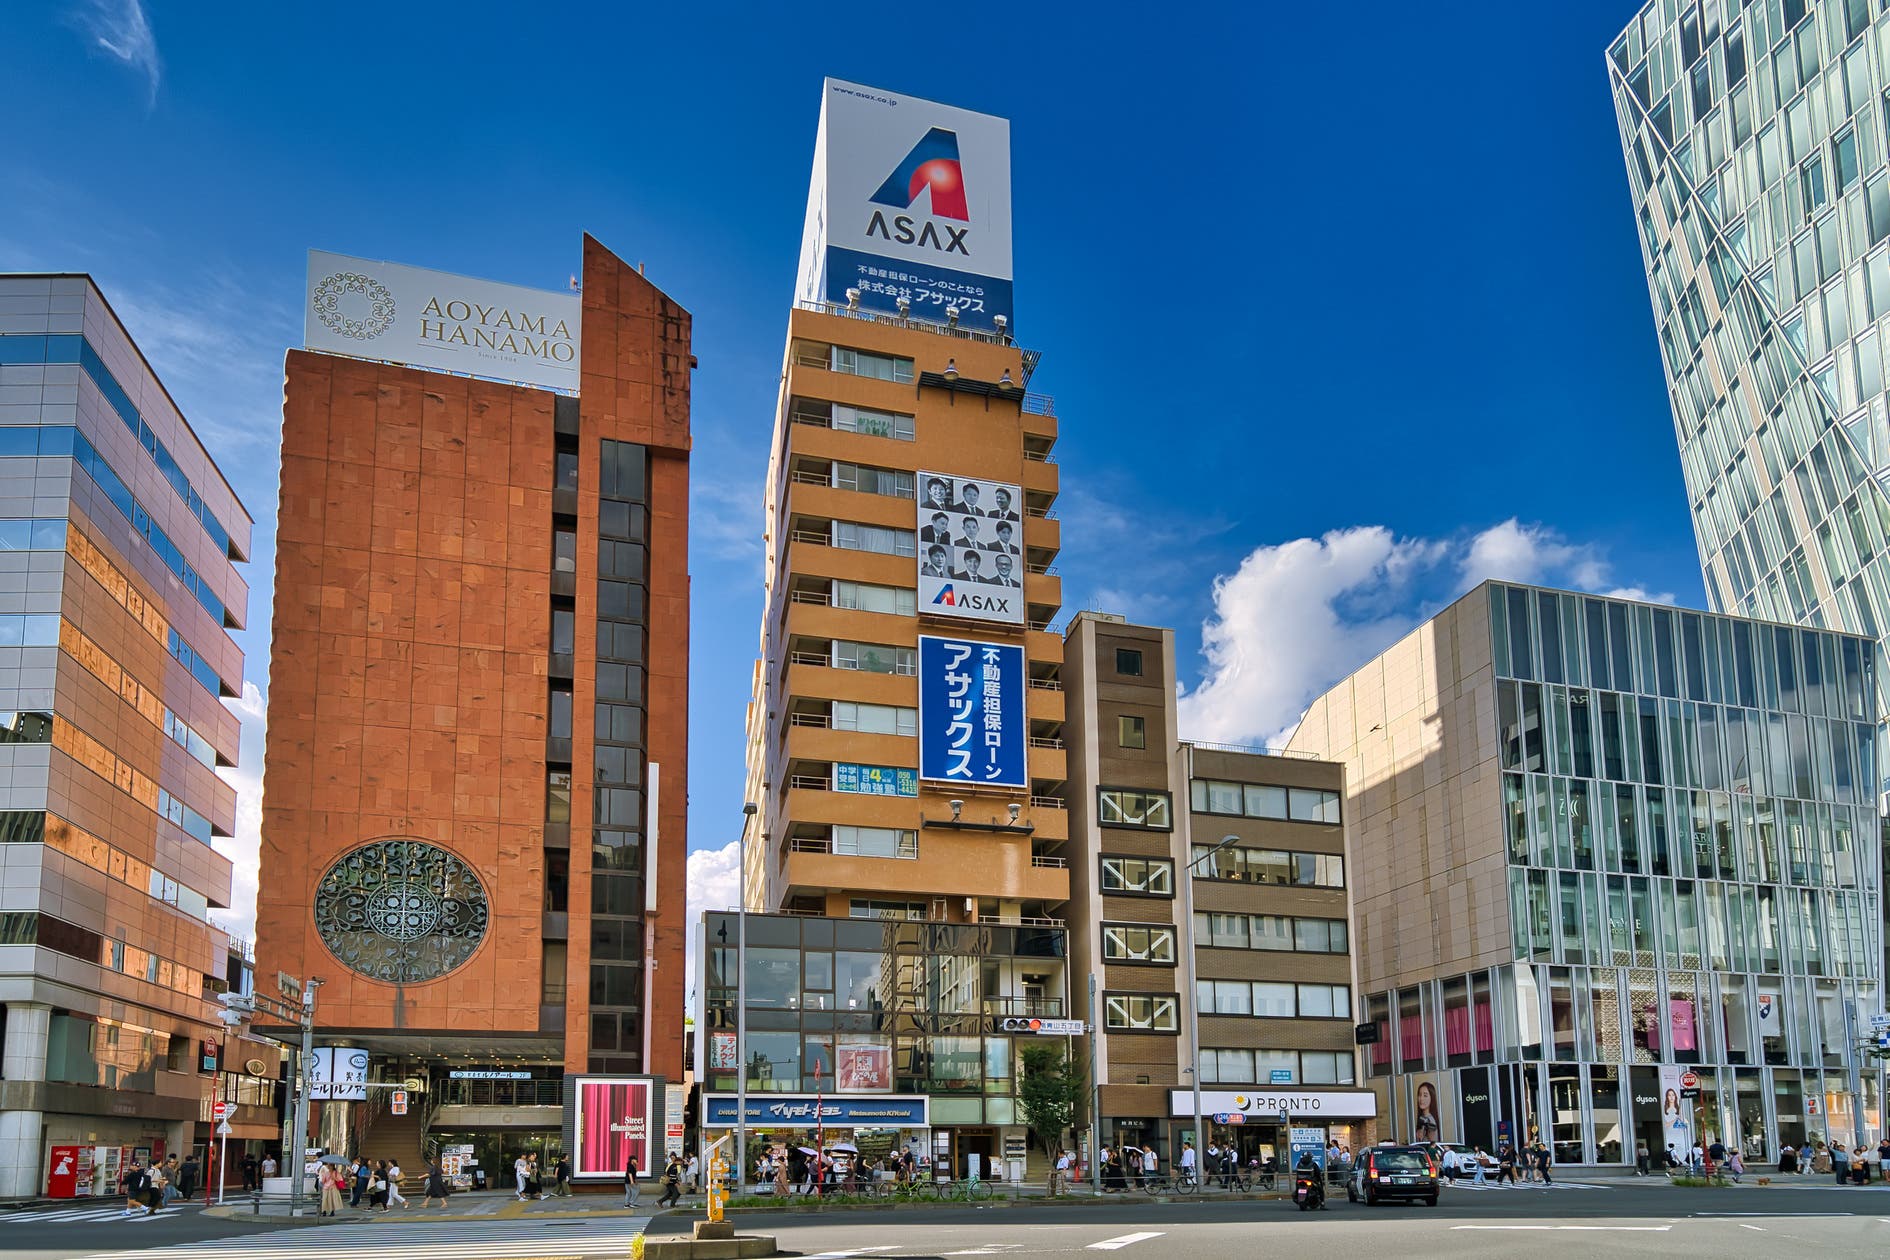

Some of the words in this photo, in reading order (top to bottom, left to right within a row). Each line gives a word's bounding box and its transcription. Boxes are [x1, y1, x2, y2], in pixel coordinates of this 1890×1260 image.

[832, 86, 897, 106] www.asax.co.jp
[865, 210, 970, 256] ASAX
[857, 264, 984, 296] 不動産担保ローンのことなら
[422, 296, 573, 340] AOYAMA
[419, 318, 575, 363] HANAMO
[958, 594, 1009, 613] ASAX
[943, 643, 973, 778] アサックス
[982, 647, 1002, 779] 不動産担保ローン
[870, 769, 881, 782] 4
[1257, 1098, 1321, 1110] PRONTO
[1466, 1094, 1488, 1104] dyson
[1635, 1094, 1658, 1105] dyson
[624, 1116, 644, 1124] Street
[769, 1102, 842, 1119] マツモトキヨシ
[610, 1123, 645, 1132] Illuminated
